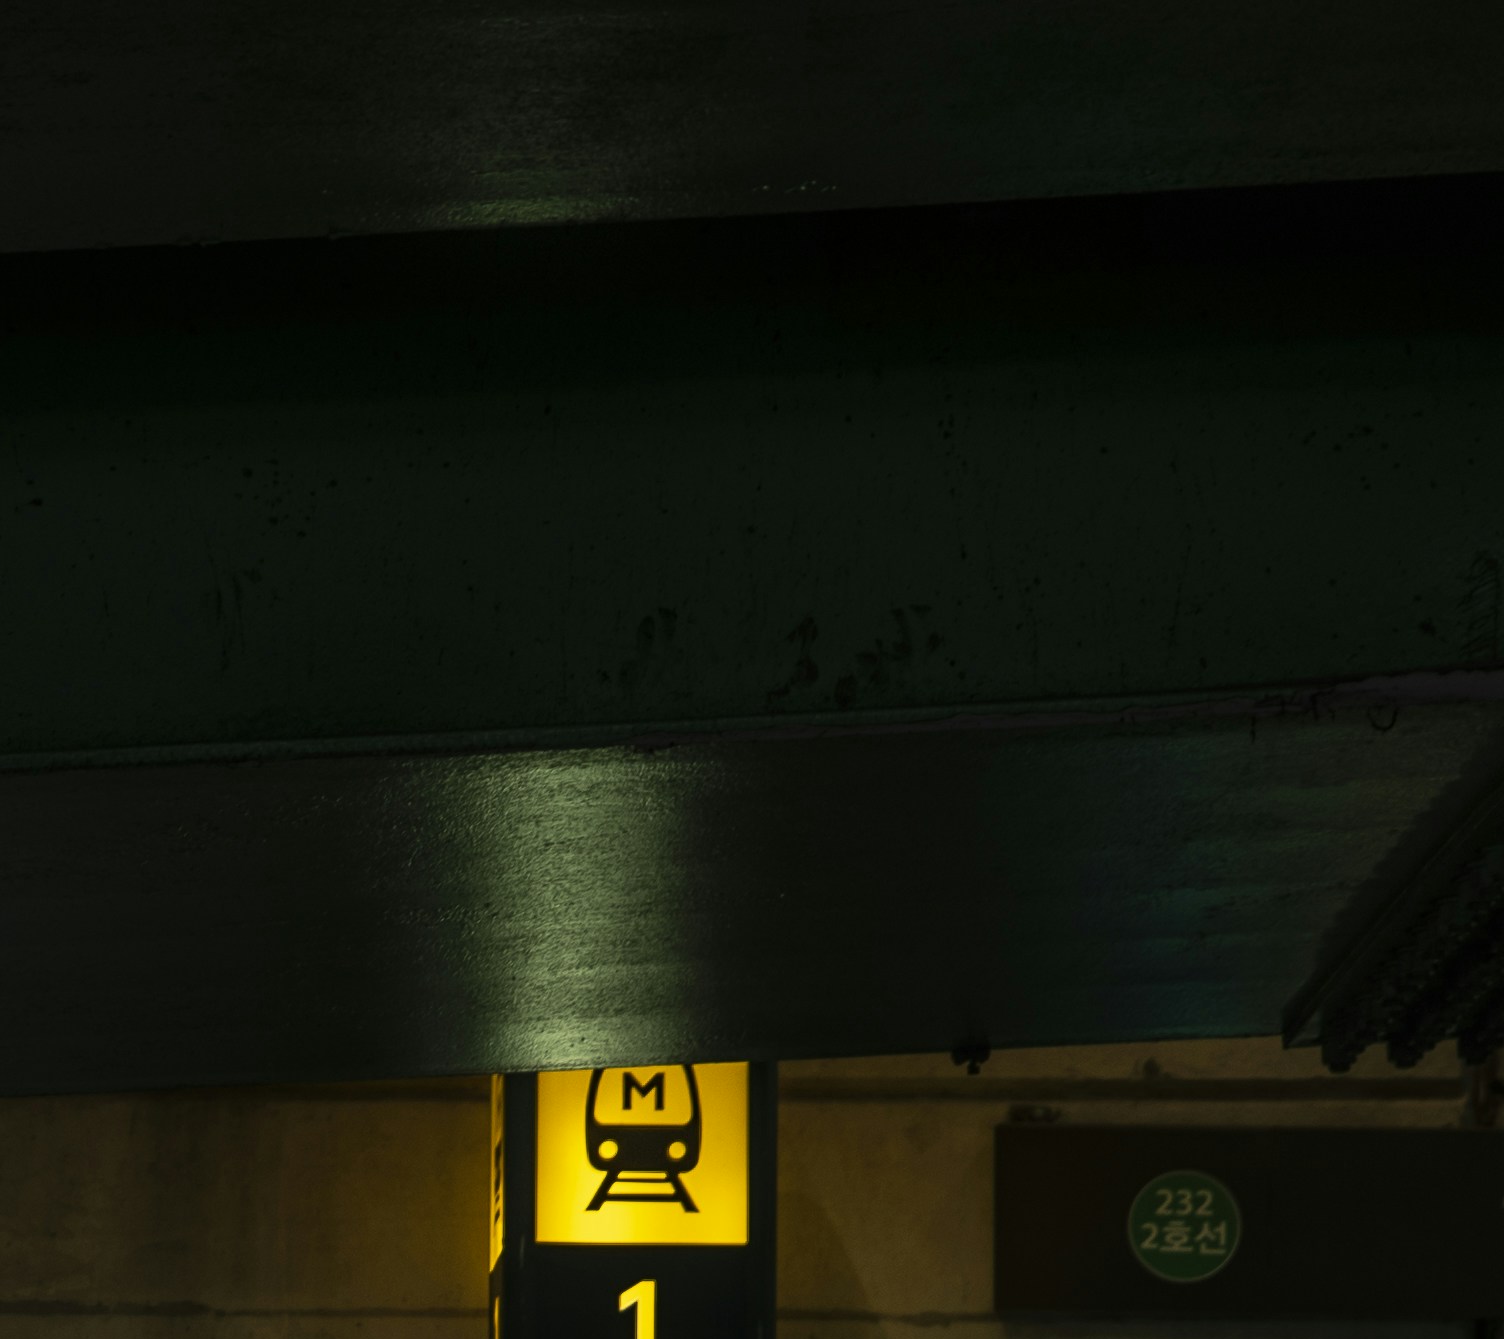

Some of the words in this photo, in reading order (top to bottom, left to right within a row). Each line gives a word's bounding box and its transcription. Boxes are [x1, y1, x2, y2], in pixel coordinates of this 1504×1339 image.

[621, 1071, 667, 1112] M
[1154, 1188, 1214, 1217] 232
[1140, 1219, 1227, 1255] 2호선
